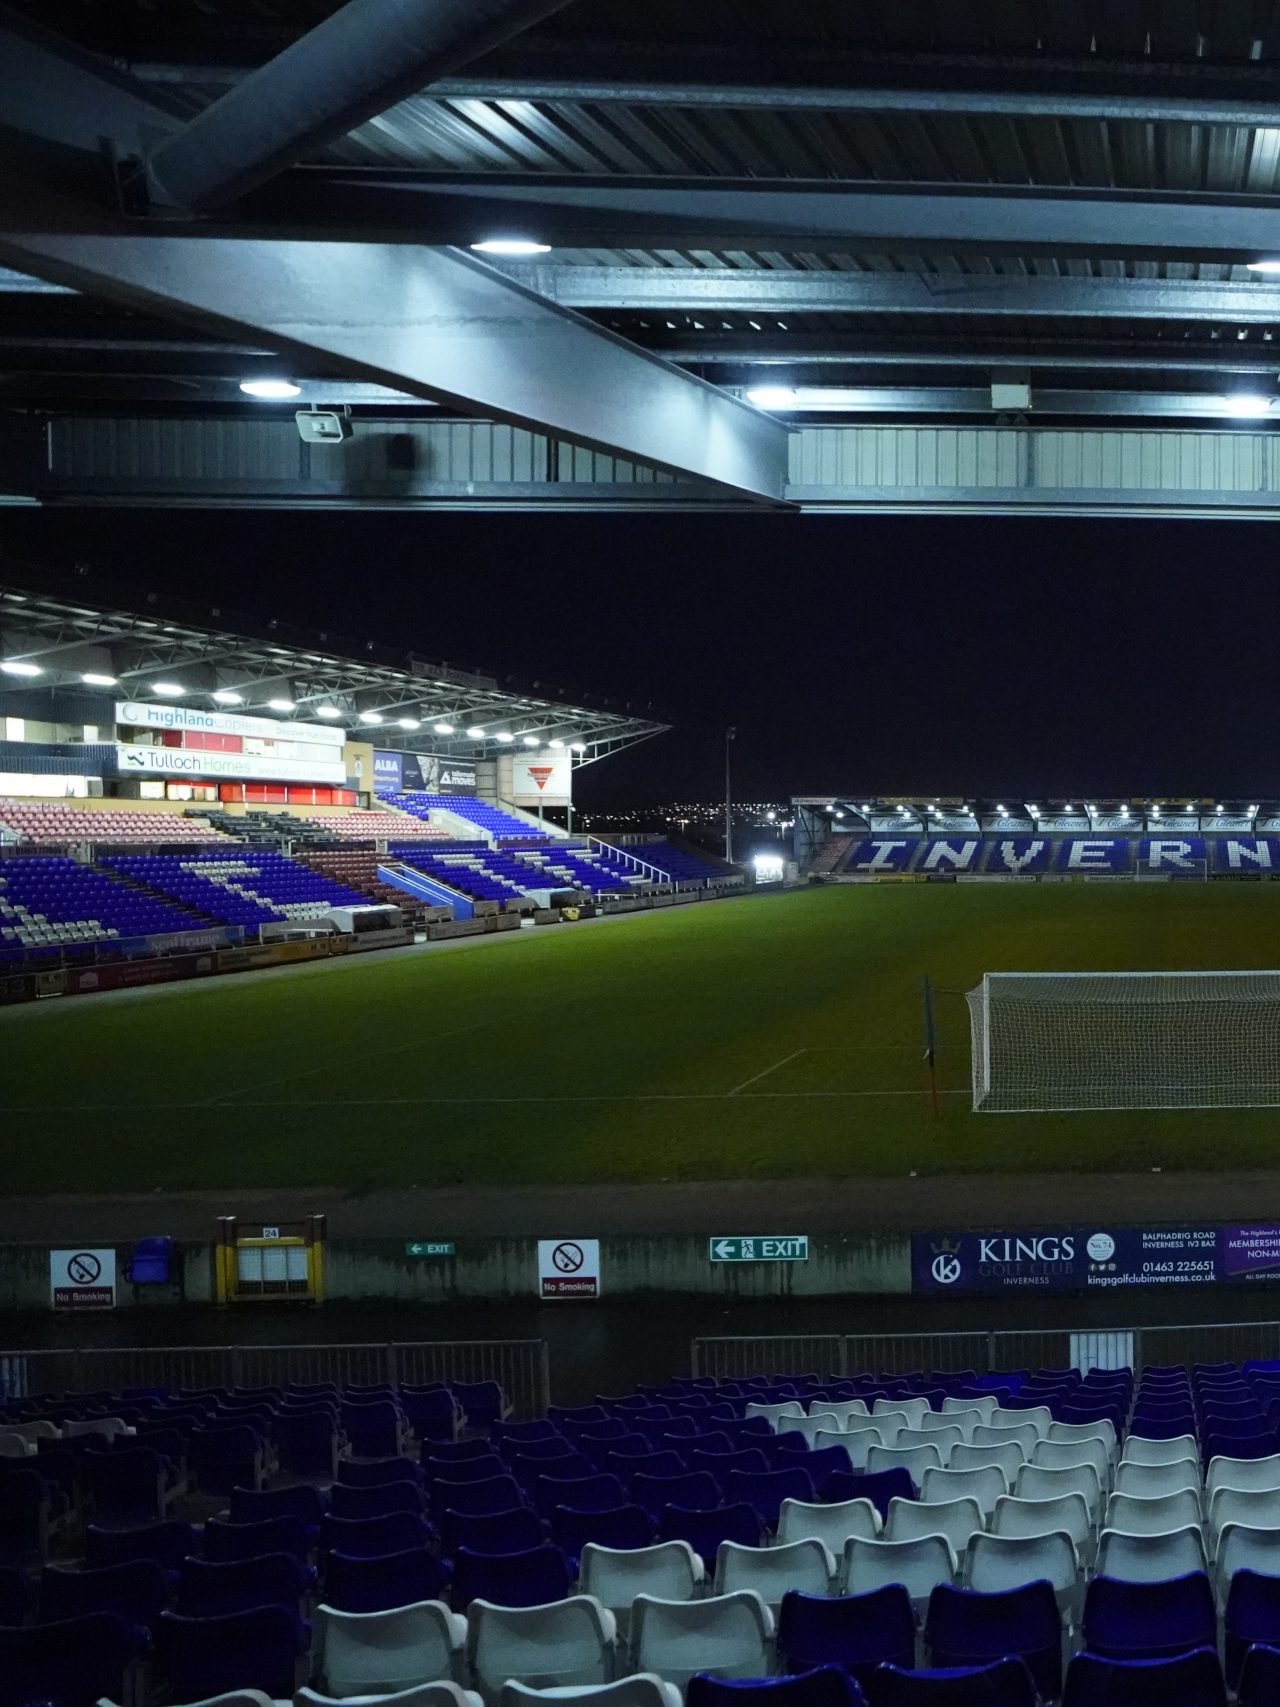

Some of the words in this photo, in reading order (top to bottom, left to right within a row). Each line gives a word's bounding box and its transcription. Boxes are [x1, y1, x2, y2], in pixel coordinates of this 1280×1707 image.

[147, 751, 201, 770] Tulloch
[203, 758, 251, 774] Homes
[374, 759, 399, 772] ALBA
[451, 777, 476, 786] moves
[264, 1229, 277, 1237] 24
[1142, 1232, 1191, 1241] BALPHADRIG
[1193, 1231, 1216, 1239] ROAD
[427, 1244, 449, 1253] EXIT
[762, 1240, 802, 1257] EXIT
[978, 1236, 1075, 1262] KINGS
[1142, 1241, 1184, 1249] INVERNESS
[1187, 1240, 1199, 1248] IV3
[1201, 1240, 1216, 1248] 8AX
[979, 1263, 1022, 1277] GOLF
[1030, 1262, 1074, 1275] CLUB
[1142, 1262, 1174, 1272] 01463
[1176, 1261, 1214, 1271] 225651
[1003, 1276, 1050, 1285] INVERNESS
[1087, 1271, 1216, 1287] kingsgolfclubinverness.co.uk
[544, 1283, 556, 1292] No
[559, 1282, 595, 1292] Smoking
[56, 1293, 69, 1302] No
[73, 1292, 111, 1303] Smoking
